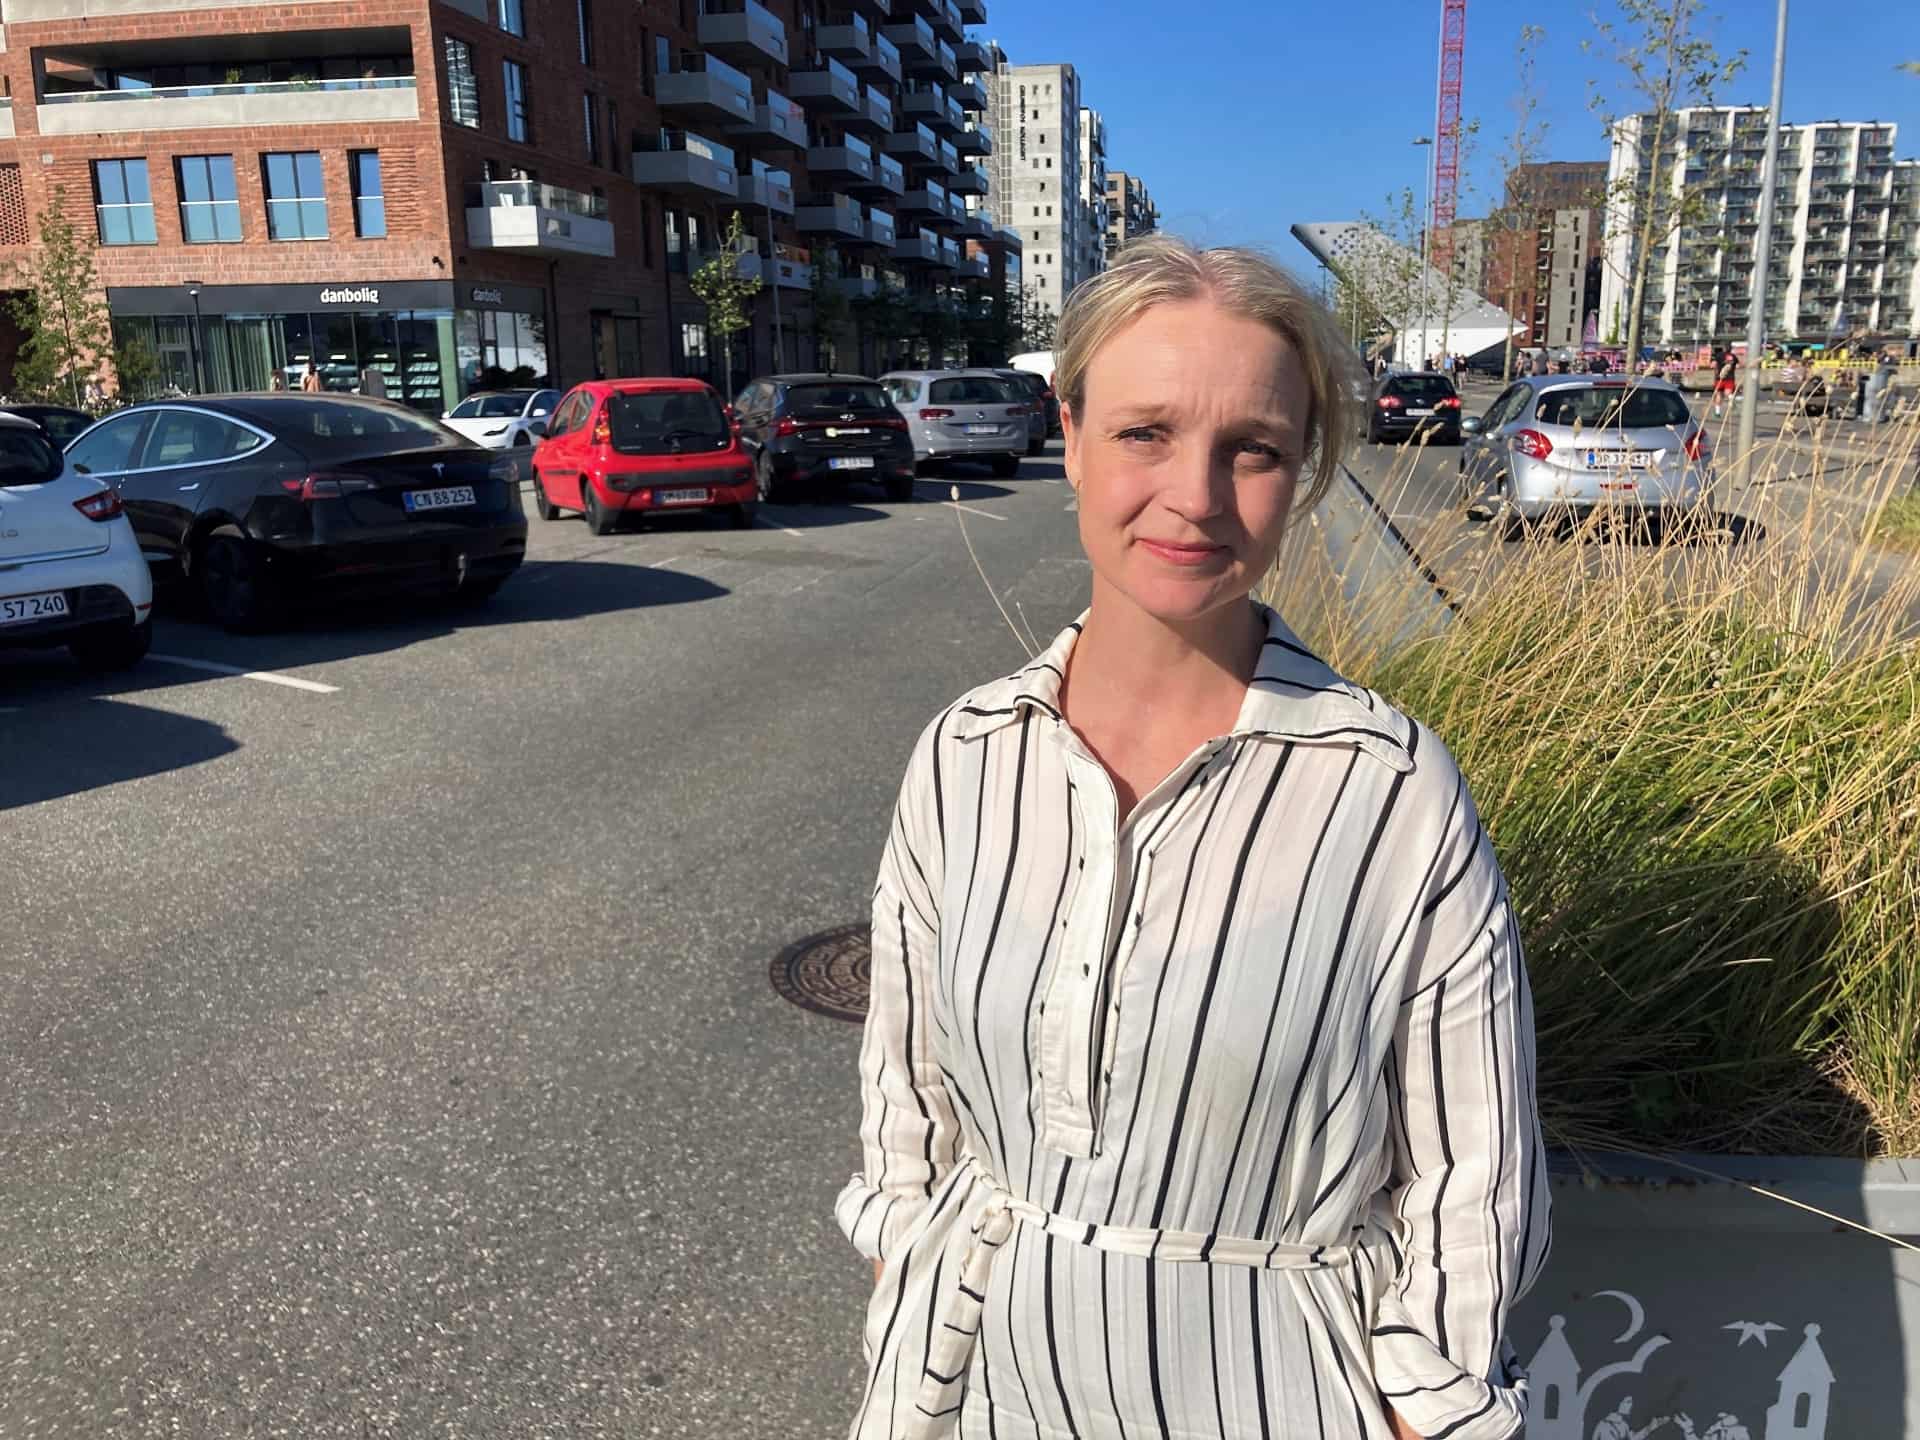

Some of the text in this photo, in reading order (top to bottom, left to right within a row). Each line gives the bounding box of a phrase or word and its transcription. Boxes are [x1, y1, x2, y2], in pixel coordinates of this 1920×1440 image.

[320, 287, 379, 304] danbolig
[433, 491, 449, 505] 88
[450, 488, 472, 504] 252
[3, 596, 65, 618] 57 240
